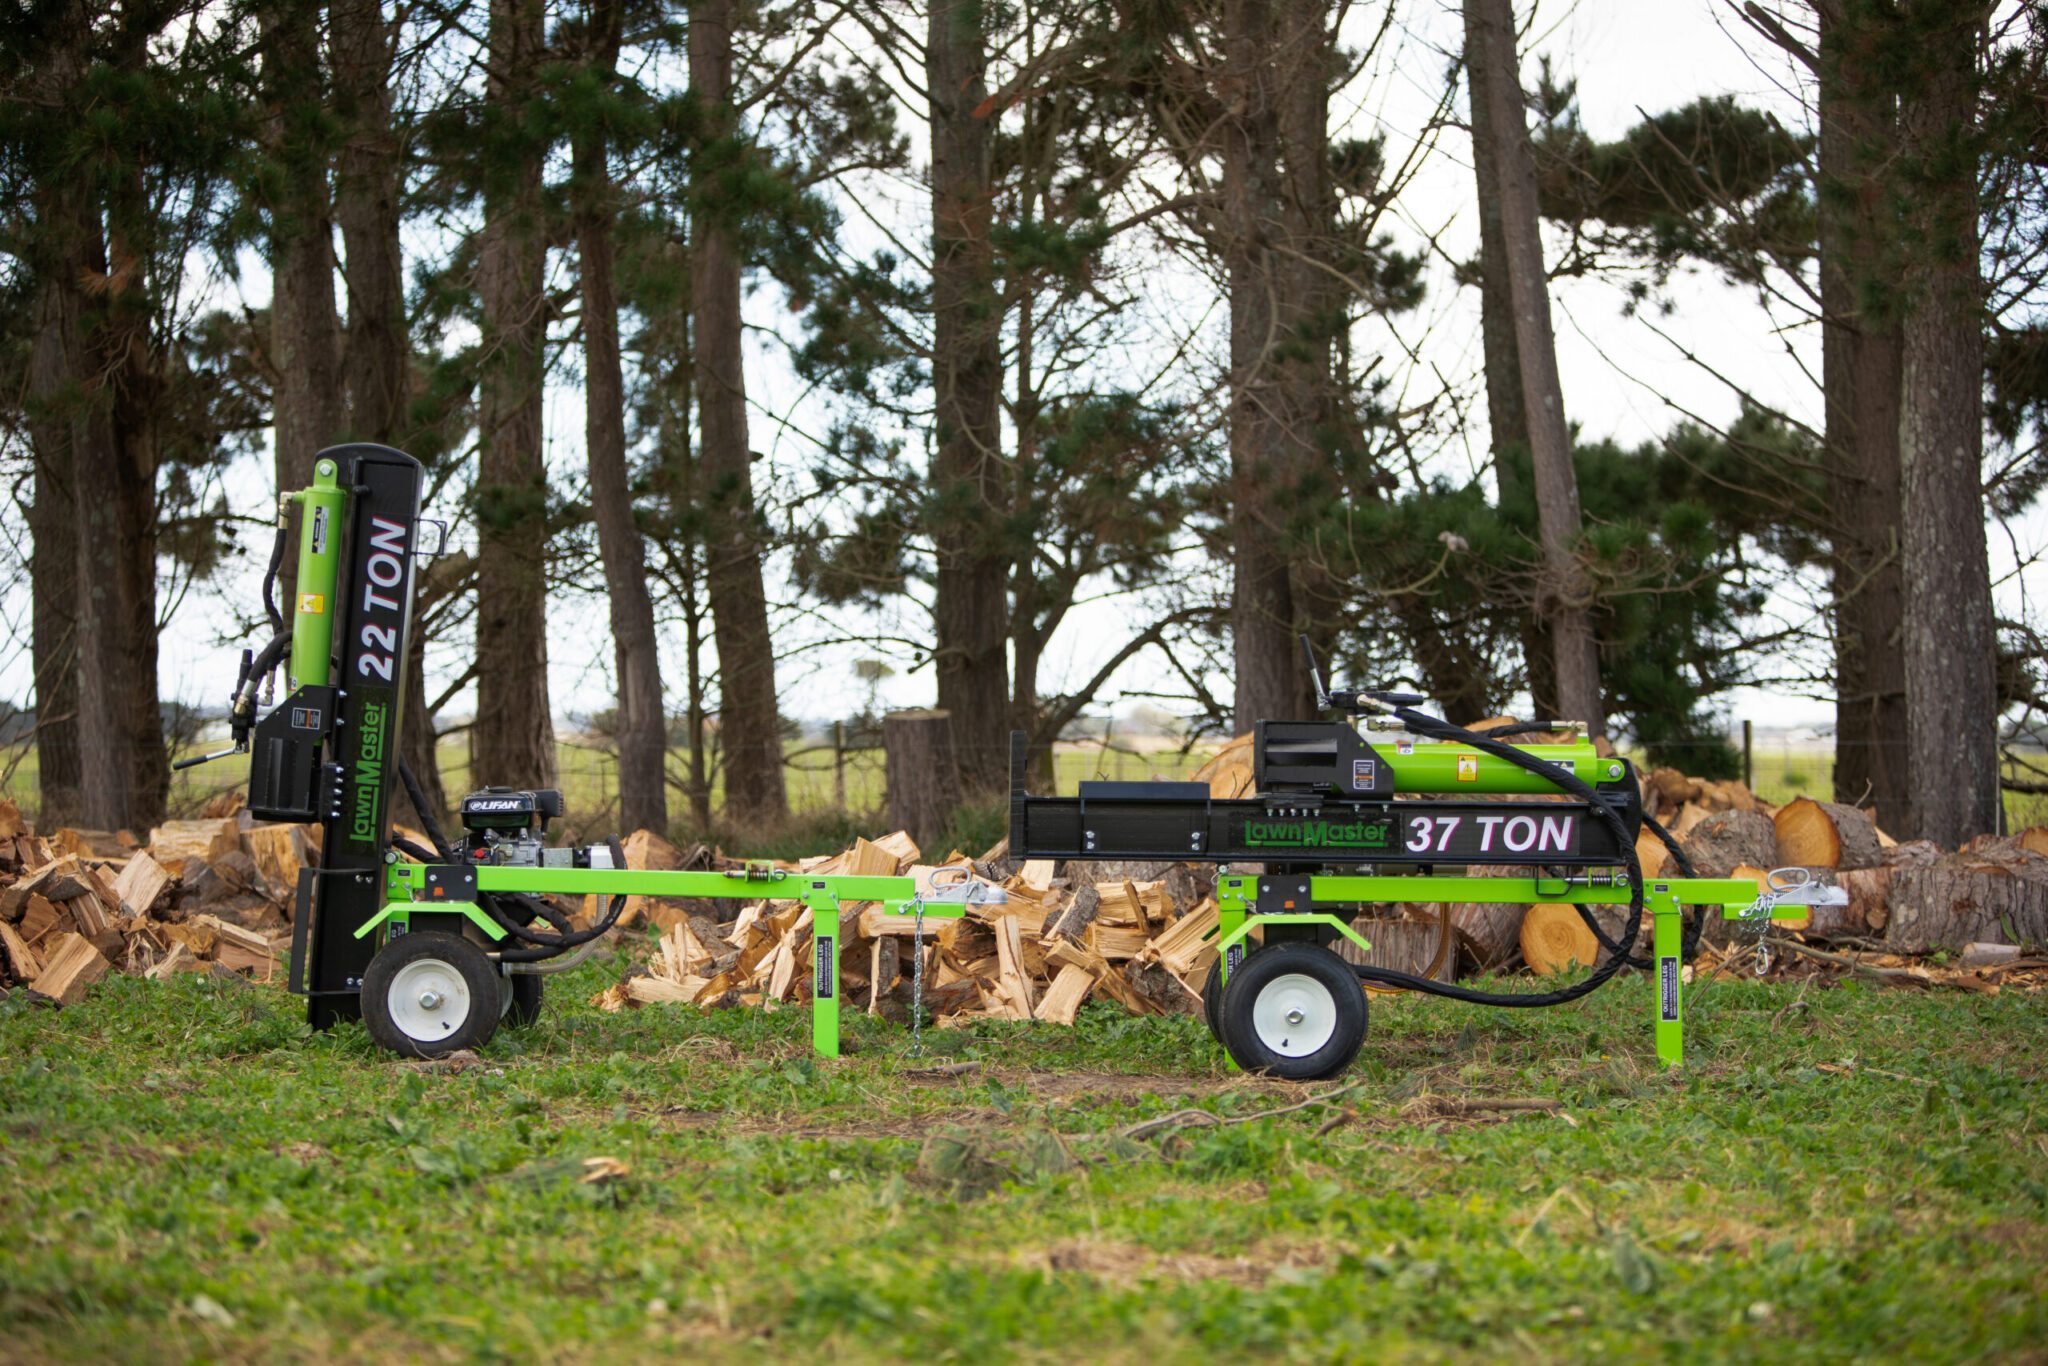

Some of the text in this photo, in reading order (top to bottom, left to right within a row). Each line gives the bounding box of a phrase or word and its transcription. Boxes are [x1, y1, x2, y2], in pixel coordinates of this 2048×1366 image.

[358, 516, 407, 682] 22 TON
[349, 702, 385, 842] LawnMaster
[481, 801, 519, 810] LIFAN
[1245, 820, 1388, 847] LawnMaster
[1406, 815, 1574, 852] 37 TON
